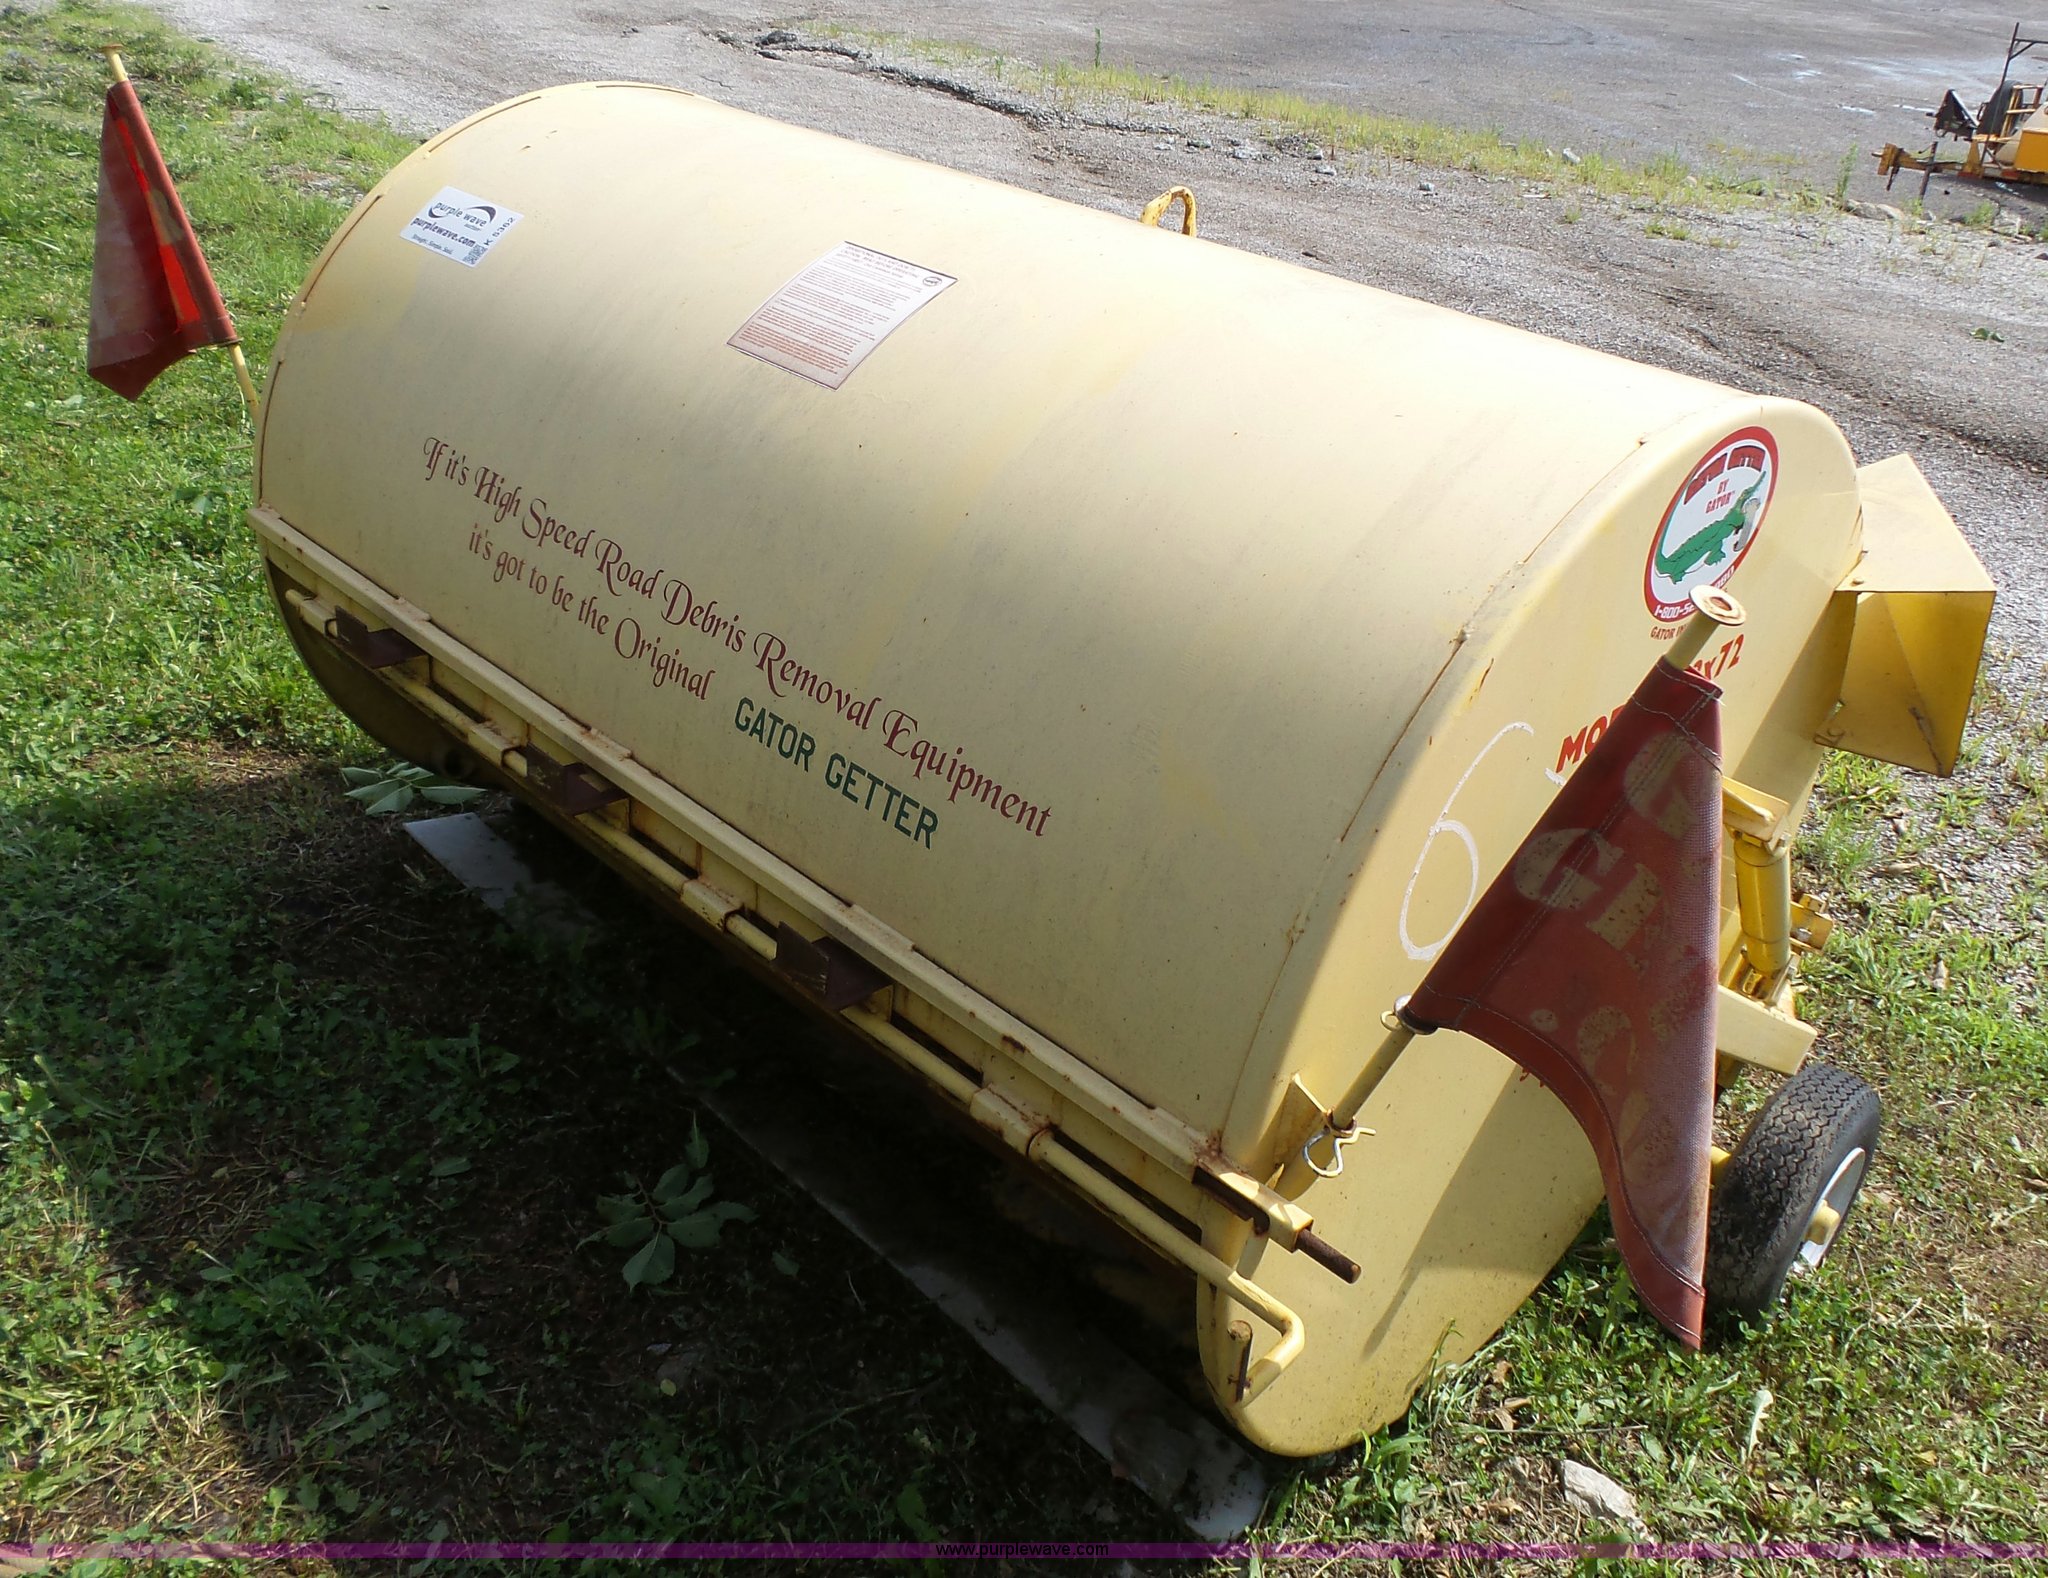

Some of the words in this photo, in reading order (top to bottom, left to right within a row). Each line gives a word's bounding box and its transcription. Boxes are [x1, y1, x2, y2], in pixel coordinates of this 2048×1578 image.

[433, 201, 462, 217] purple
[463, 211, 487, 227] wave
[410, 216, 477, 248] purplewave.com
[423, 437, 447, 482] If
[444, 449, 469, 486] it's
[474, 466, 521, 524] High
[522, 498, 595, 559] Speed
[595, 538, 663, 600] Road
[661, 579, 747, 653] Debris
[752, 631, 881, 731] Removal
[882, 709, 1053, 838] Equipment
[1650, 625, 1675, 641] GATOR
[469, 523, 494, 560] it's
[493, 549, 526, 584] got
[529, 563, 547, 595] to
[551, 575, 574, 613] be
[577, 596, 609, 636] the
[615, 617, 717, 701] Original
[734, 697, 817, 773] GATOR
[824, 753, 939, 850] GETTER
